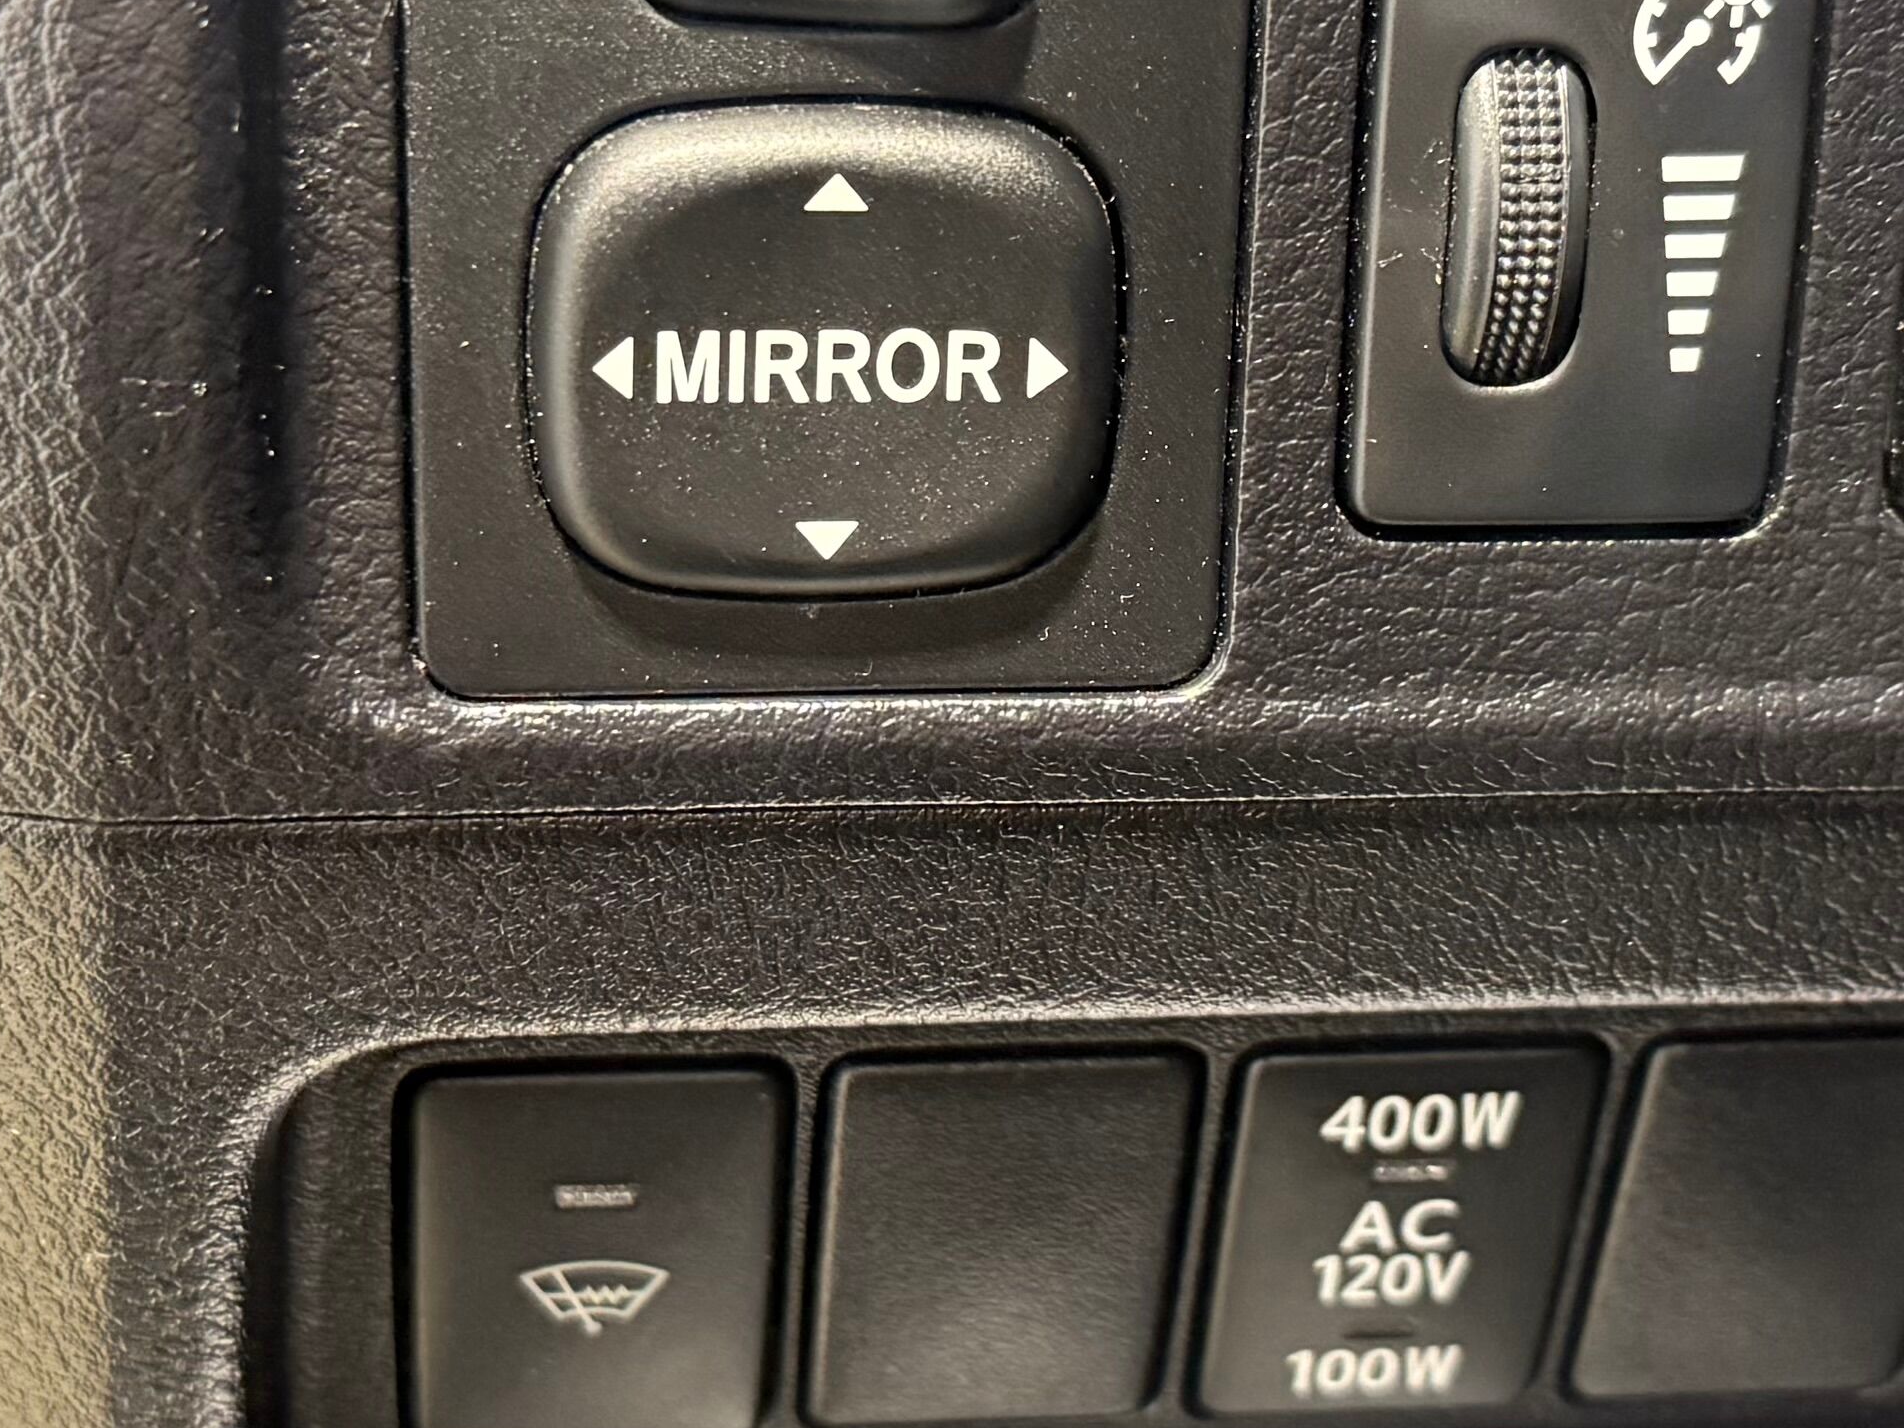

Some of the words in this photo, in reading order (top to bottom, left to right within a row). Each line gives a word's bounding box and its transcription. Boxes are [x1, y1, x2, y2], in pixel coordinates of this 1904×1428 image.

[655, 327, 1002, 404] MIRROR
[1318, 1089, 1522, 1153] 400W
[1338, 1197, 1460, 1253] AC
[1311, 1251, 1471, 1307] 120V
[1284, 1344, 1463, 1399] 100W
